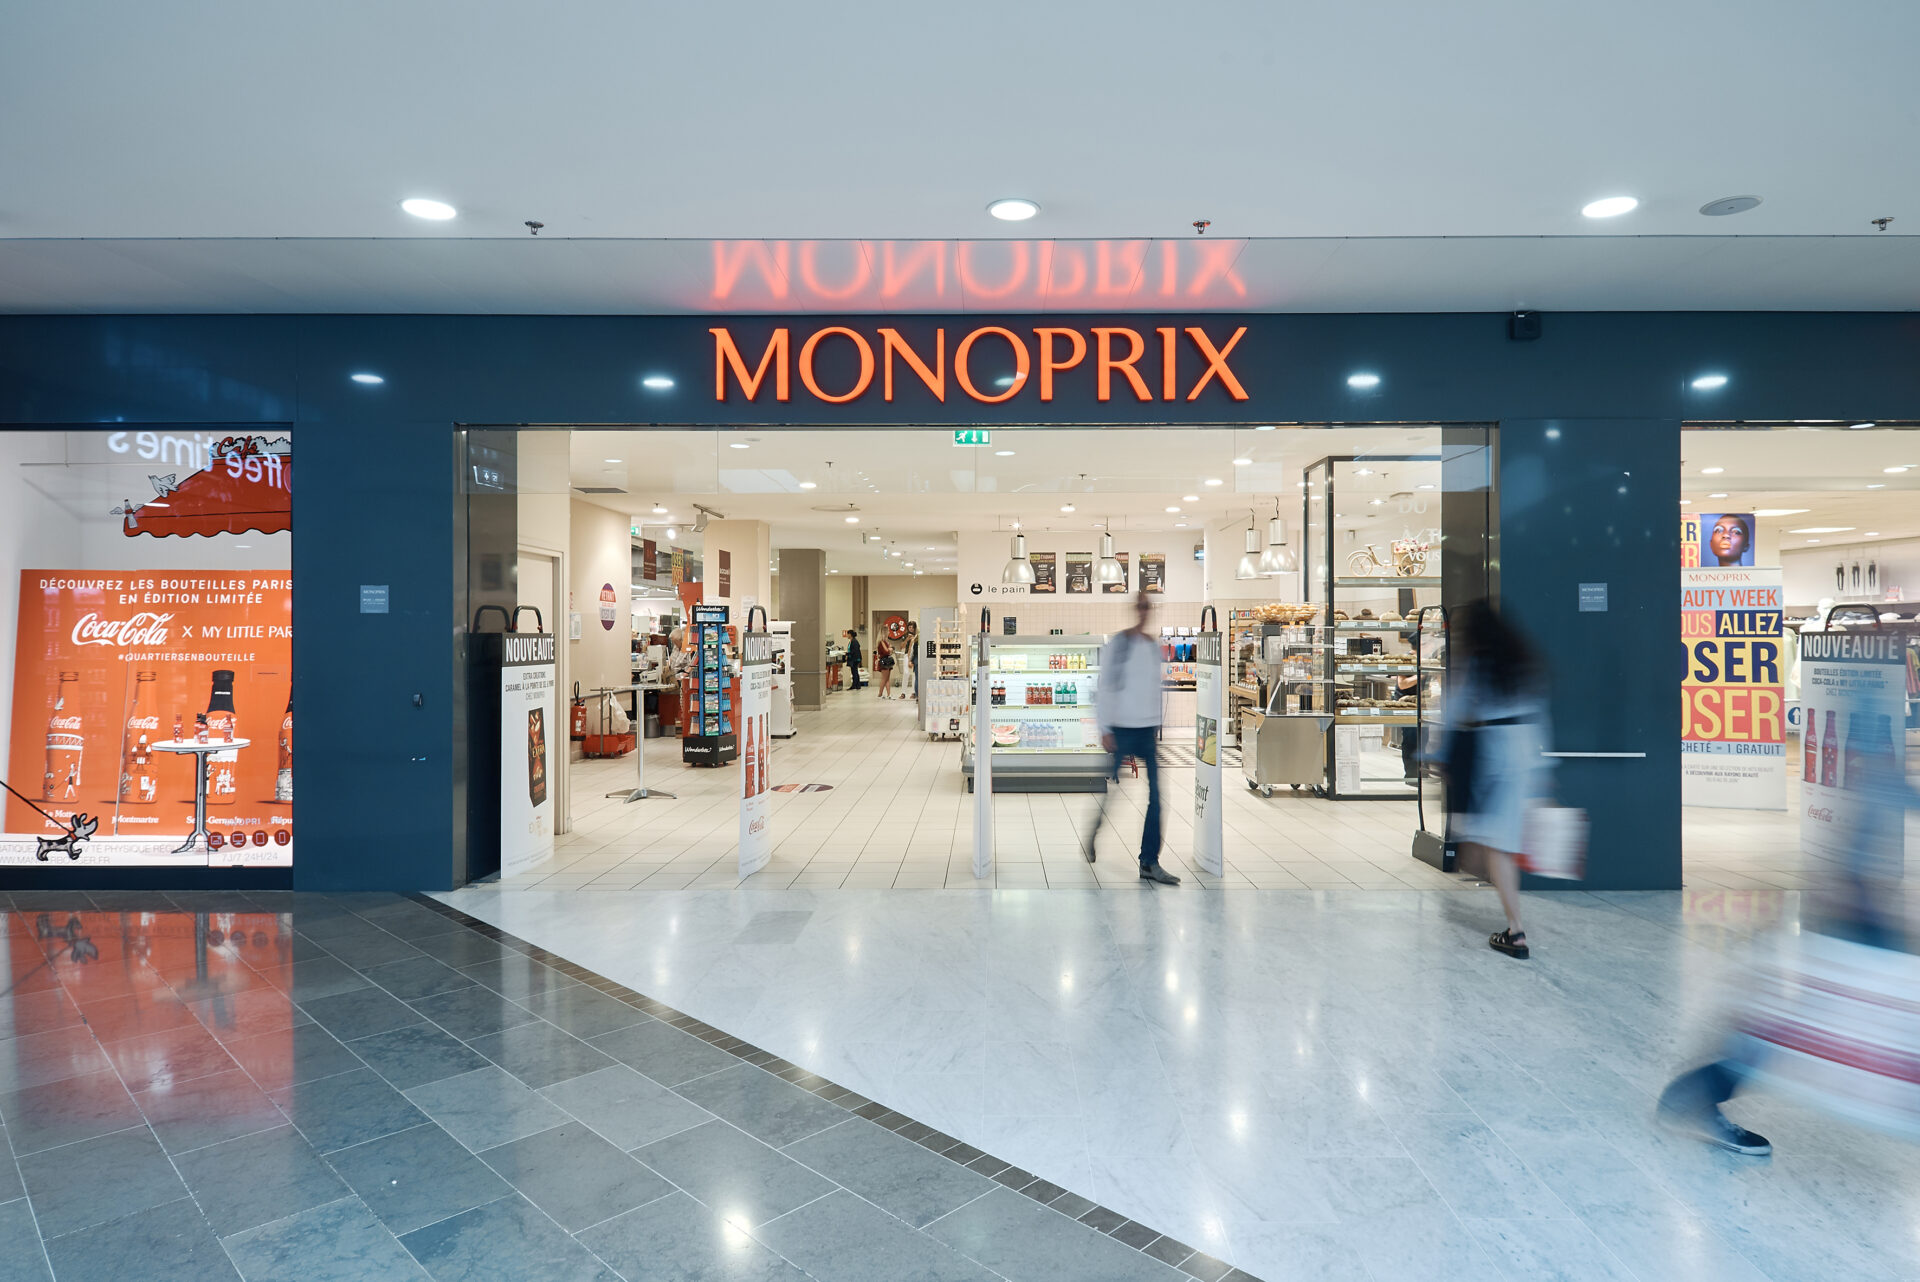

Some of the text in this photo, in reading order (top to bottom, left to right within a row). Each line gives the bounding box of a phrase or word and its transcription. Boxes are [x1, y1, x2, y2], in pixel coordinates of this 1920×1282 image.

[708, 326, 1250, 402] MONOPRIX
[40, 577, 292, 591] DÉCOUVREZ LES BOUTEILLES PARIS
[1689, 573, 1751, 582] MONOPRIX
[119, 592, 263, 604] EN ÉDITION LIMITÉE
[988, 585, 1025, 595] le pain
[1681, 589, 1777, 607] AUTY WEEK
[72, 612, 175, 646] Coca-Cola
[202, 625, 223, 638] MY
[226, 625, 265, 638] LITTLE
[1719, 612, 1780, 635] ALLEZ
[506, 633, 554, 662] NOUVEAUTÉ
[1804, 631, 1899, 660] NOUVEAUTÉ
[118, 652, 256, 662] #QUARTIERSENBOUTEILLE
[1736, 743, 1781, 755] GRATUIT
